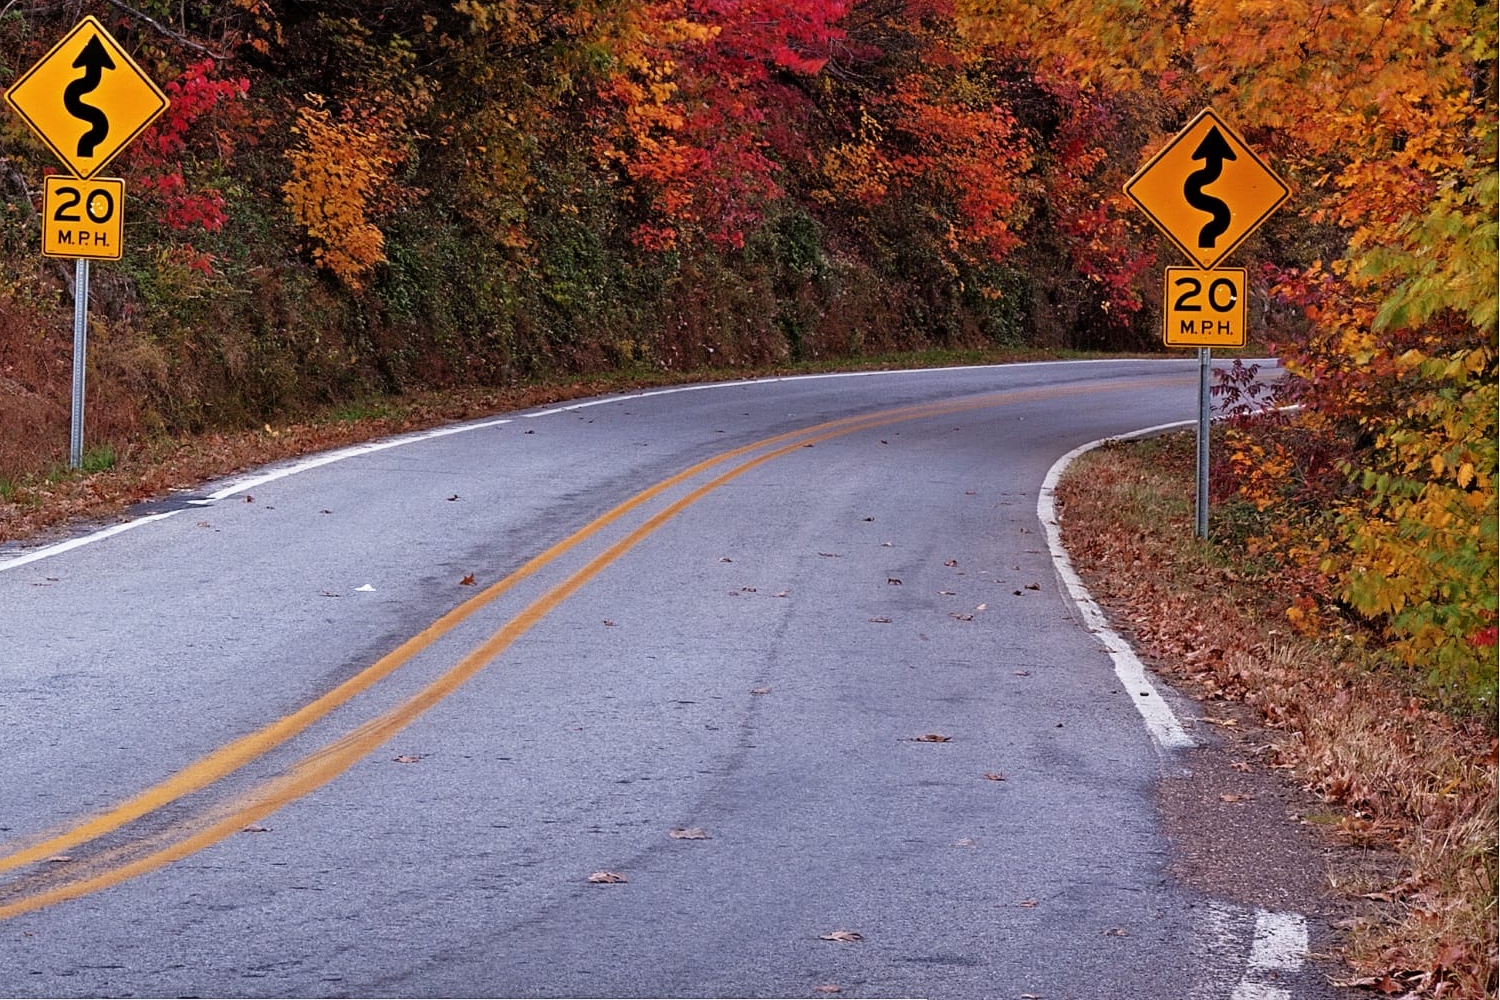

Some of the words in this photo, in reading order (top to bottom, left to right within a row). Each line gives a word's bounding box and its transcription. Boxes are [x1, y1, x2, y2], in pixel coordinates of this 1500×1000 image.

[54, 187, 114, 224] 20
[58, 230, 110, 247] M.P.H.
[1174, 277, 1237, 312] 20
[1180, 320, 1233, 335] M.P.H.
